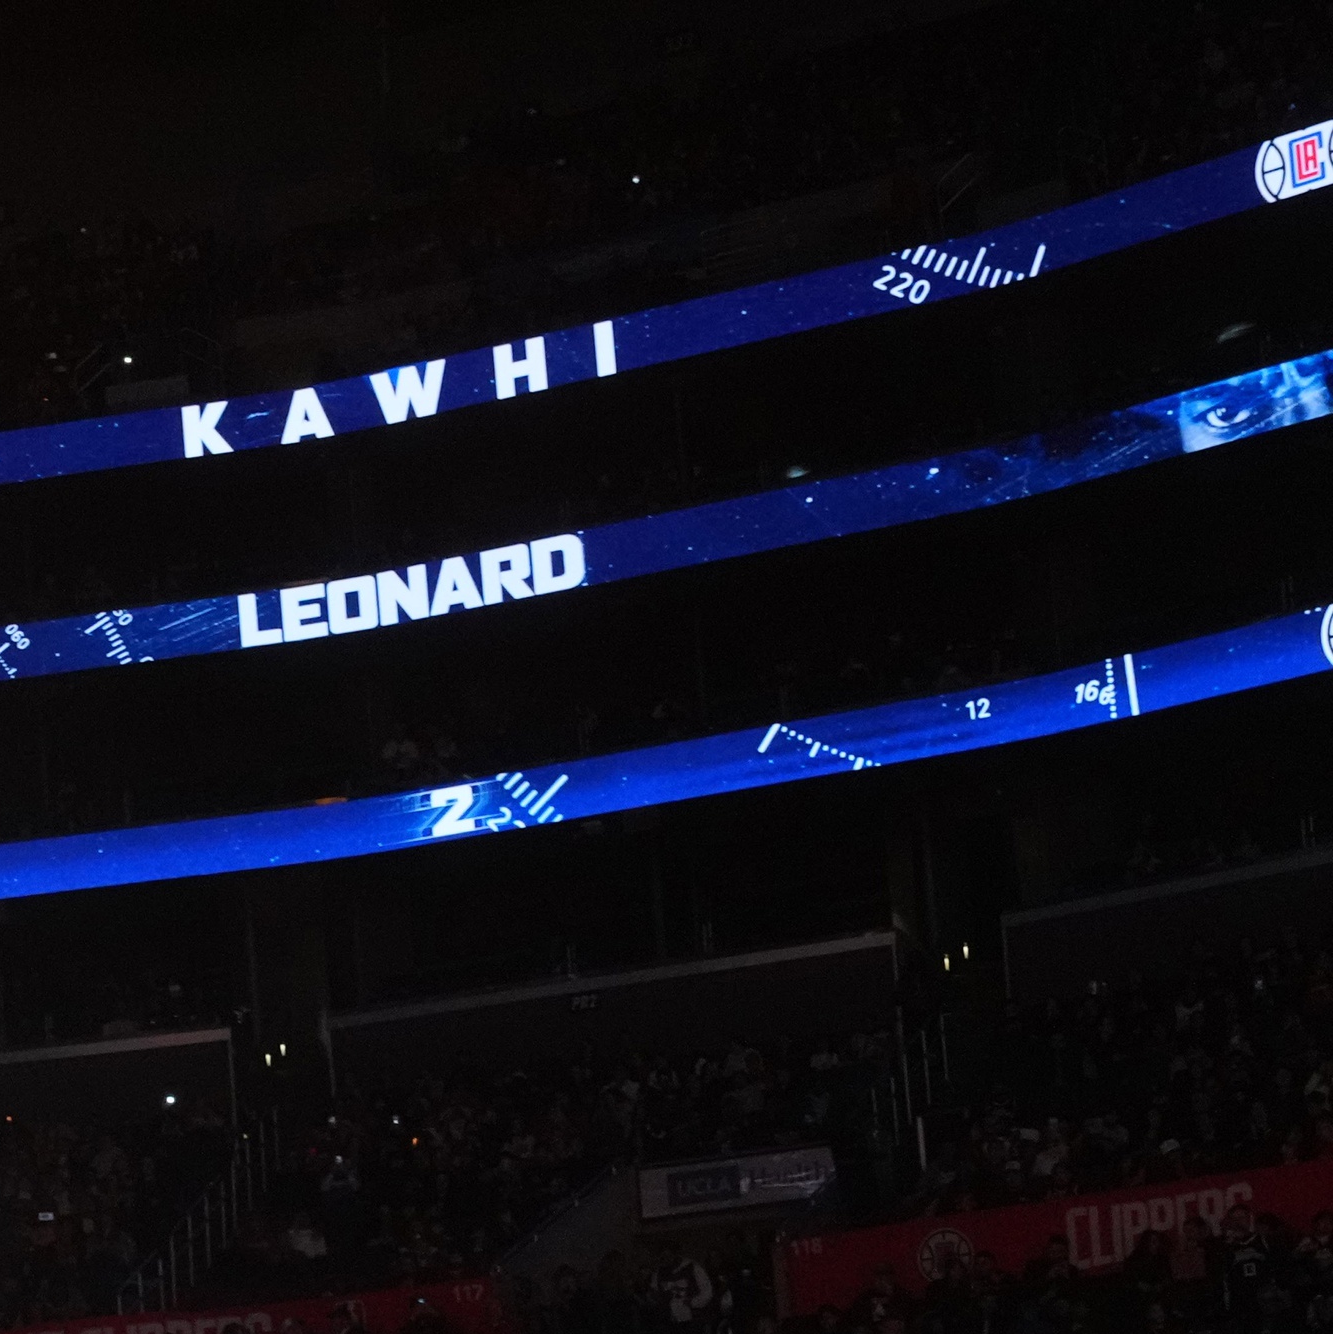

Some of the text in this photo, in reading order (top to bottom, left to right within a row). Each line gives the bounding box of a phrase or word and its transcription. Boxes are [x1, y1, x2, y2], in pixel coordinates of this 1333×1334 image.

[873, 264, 931, 304] 220
[237, 532, 586, 648] LEONARD
[964, 697, 992, 721] 12
